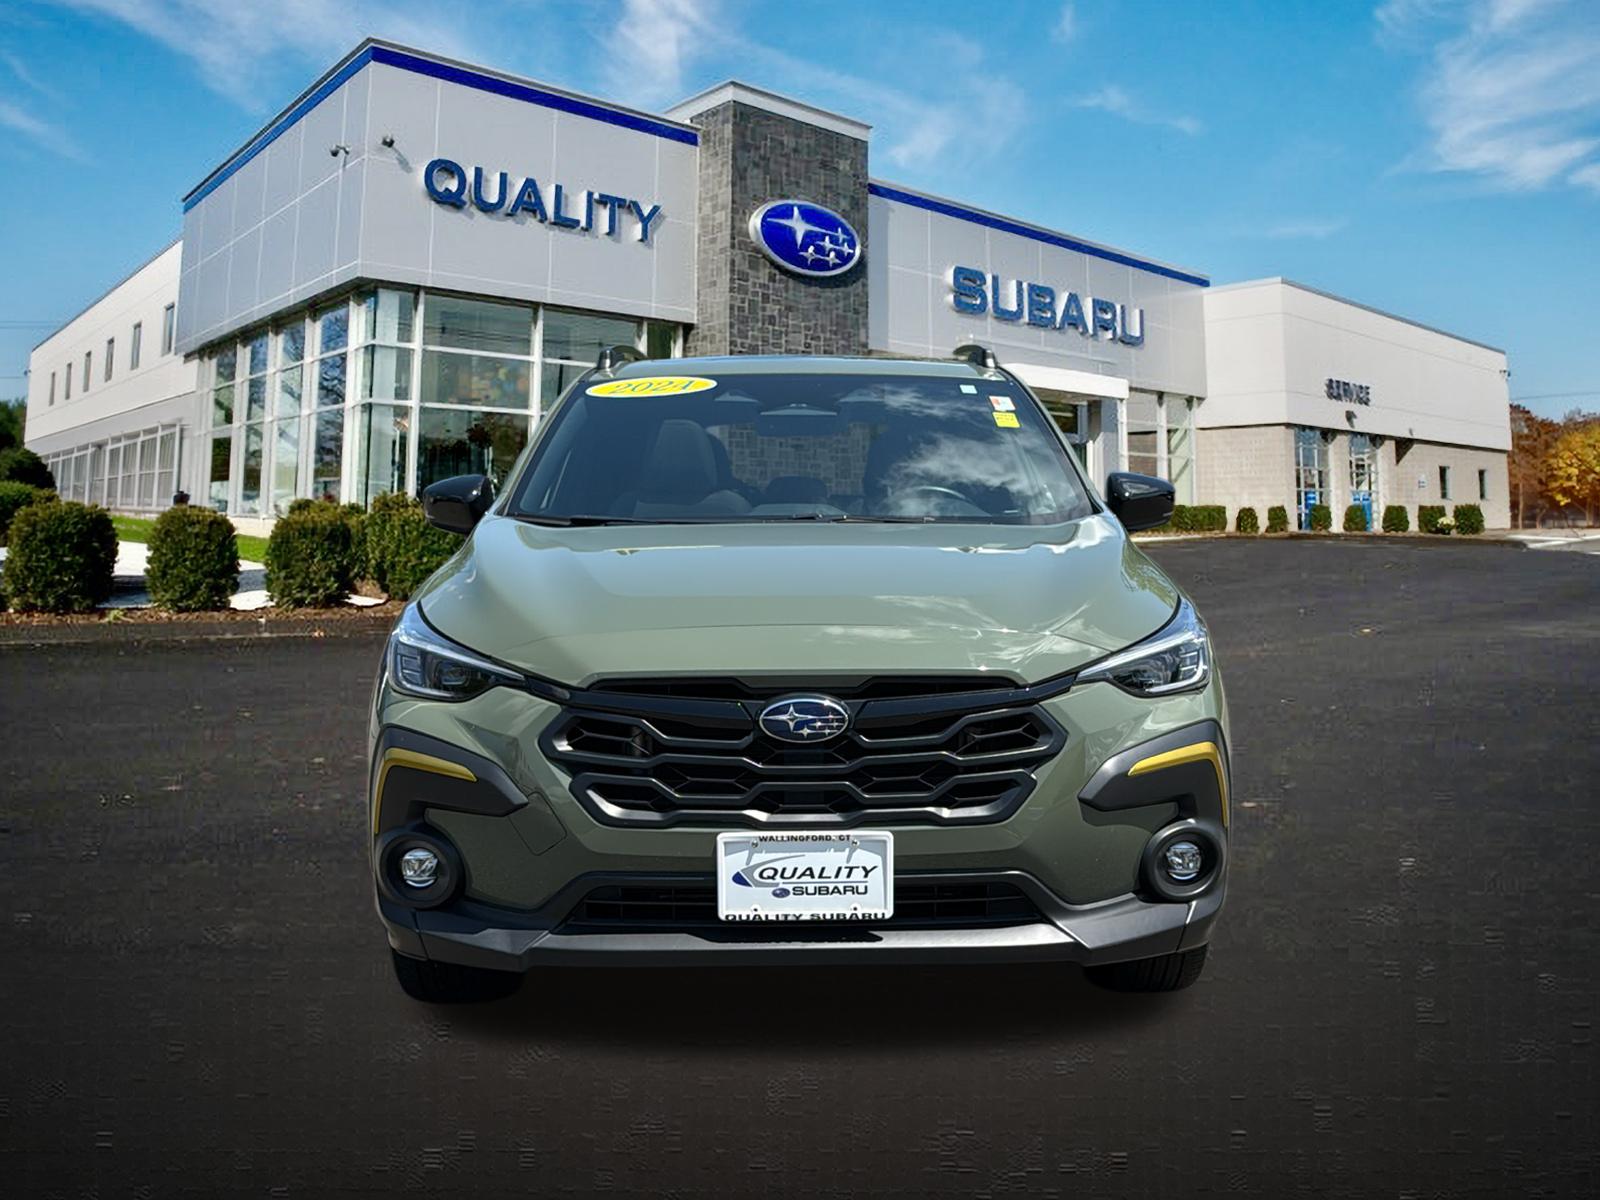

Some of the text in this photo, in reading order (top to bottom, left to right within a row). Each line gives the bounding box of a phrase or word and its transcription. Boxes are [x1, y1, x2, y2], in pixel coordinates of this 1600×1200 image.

[424, 158, 662, 242] QUALITY
[952, 265, 1145, 346] SUBARU
[608, 379, 695, 394] 2024
[1325, 378, 1371, 406] SERVICE
[758, 866, 878, 880] QUALITY
[792, 885, 868, 896] SUBARU
[725, 912, 886, 921] QUALITY SUBARU
